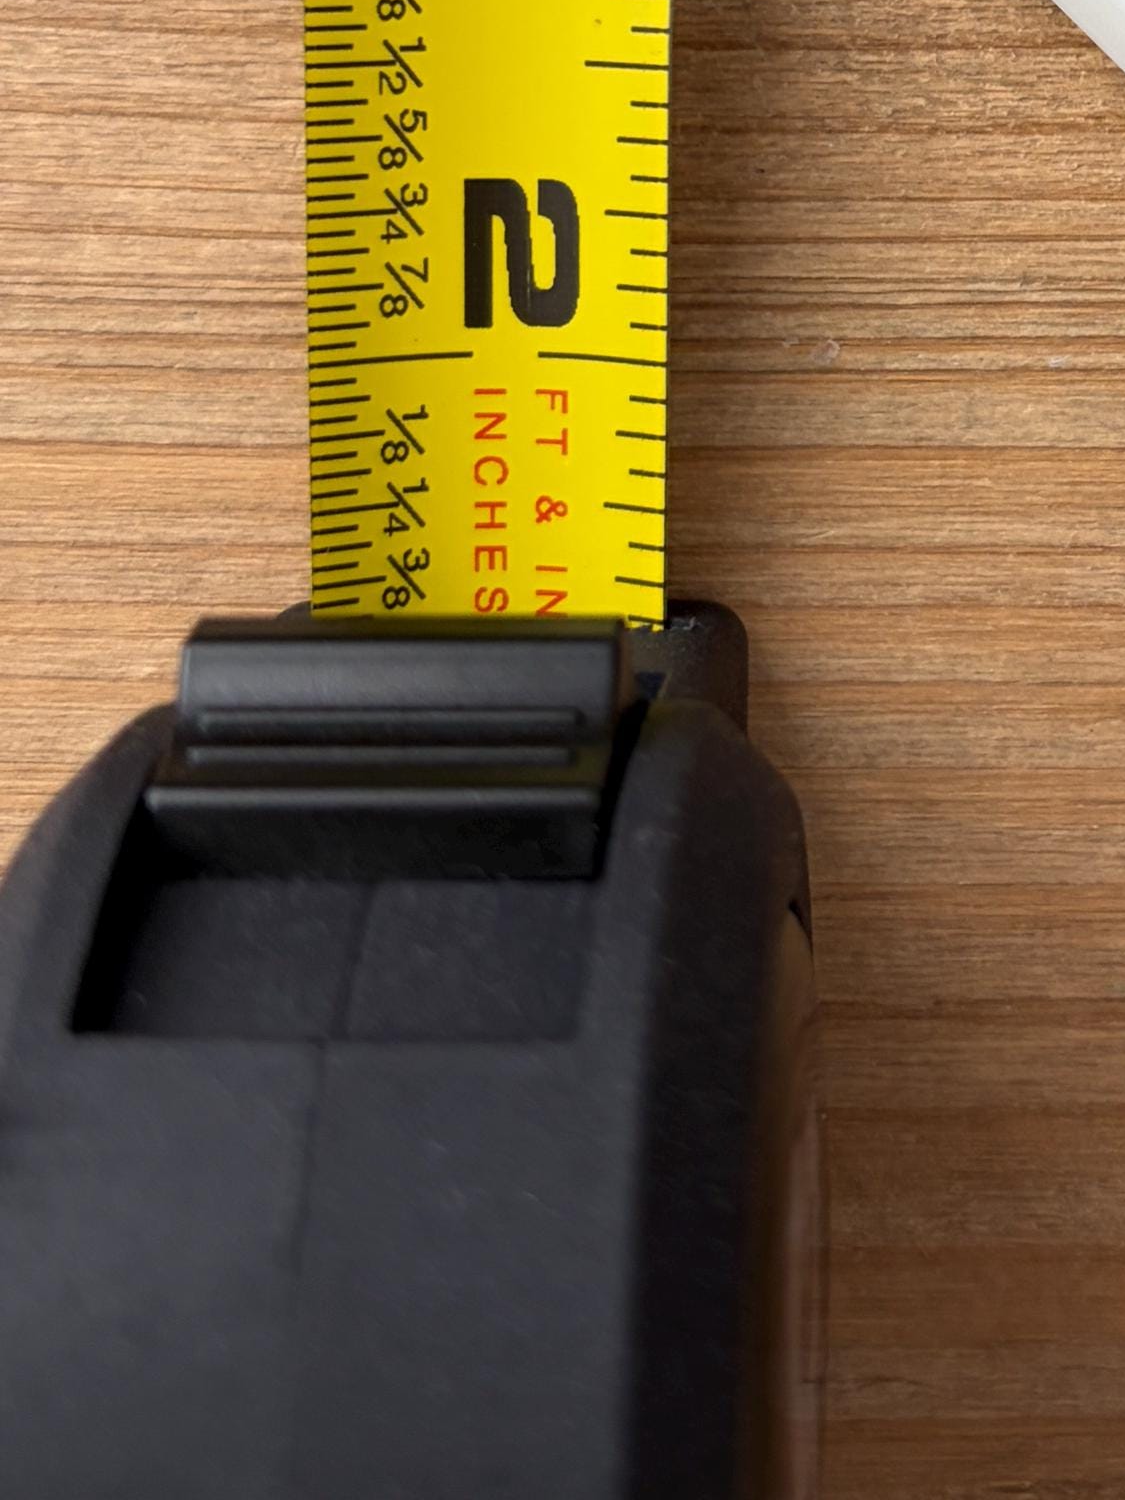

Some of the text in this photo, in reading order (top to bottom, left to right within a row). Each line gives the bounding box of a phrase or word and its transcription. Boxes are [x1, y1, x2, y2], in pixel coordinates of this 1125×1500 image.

[378, 37, 427, 95] 1/2
[377, 108, 428, 171] 5/8
[380, 182, 429, 244] 3/4
[463, 178, 580, 329] 2
[379, 257, 429, 319] 7/8
[380, 404, 429, 465] 1/8
[535, 389, 569, 456] FT
[383, 477, 430, 537] 1/4
[473, 388, 510, 613] INCHES
[535, 495, 569, 524] &
[381, 547, 431, 610] 3/8
